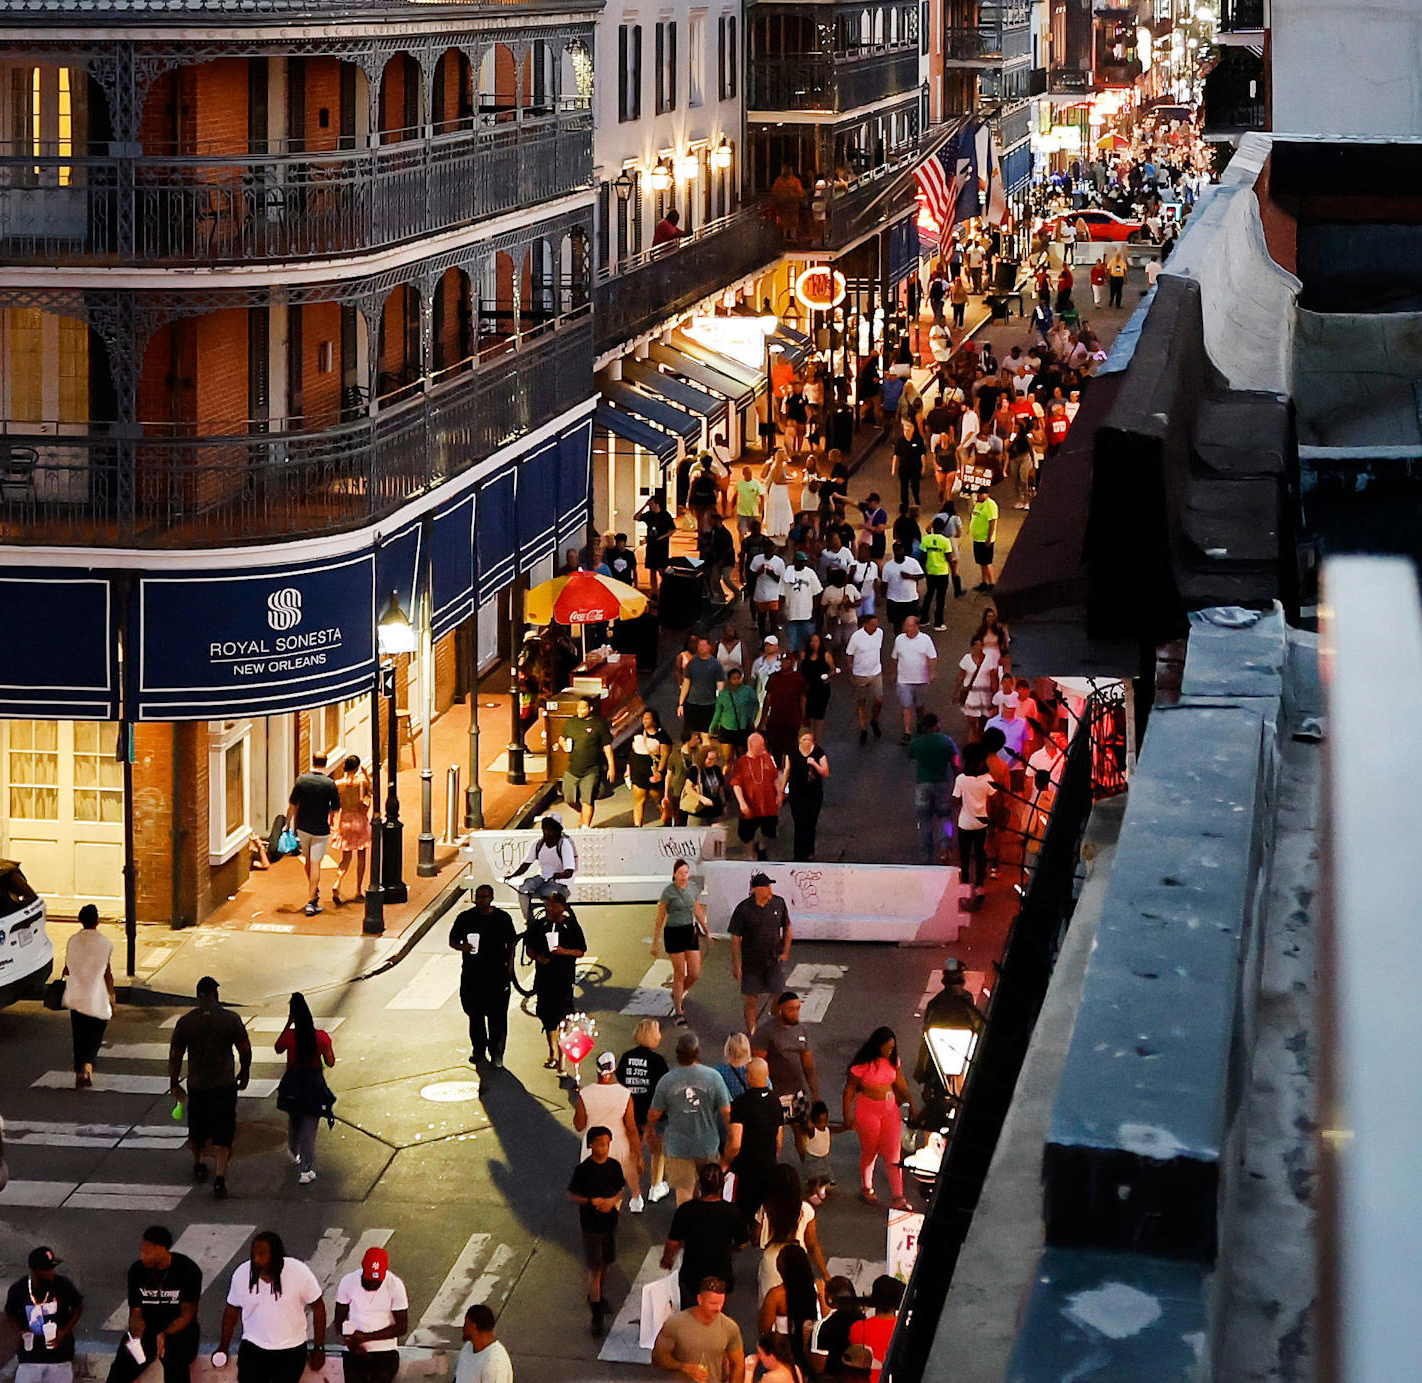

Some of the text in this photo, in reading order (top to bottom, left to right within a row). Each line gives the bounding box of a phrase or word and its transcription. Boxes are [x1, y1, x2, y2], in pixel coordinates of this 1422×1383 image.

[210, 627, 342, 657] ROYAL SONESTA
[233, 653, 327, 676] NEW ORLEANS
